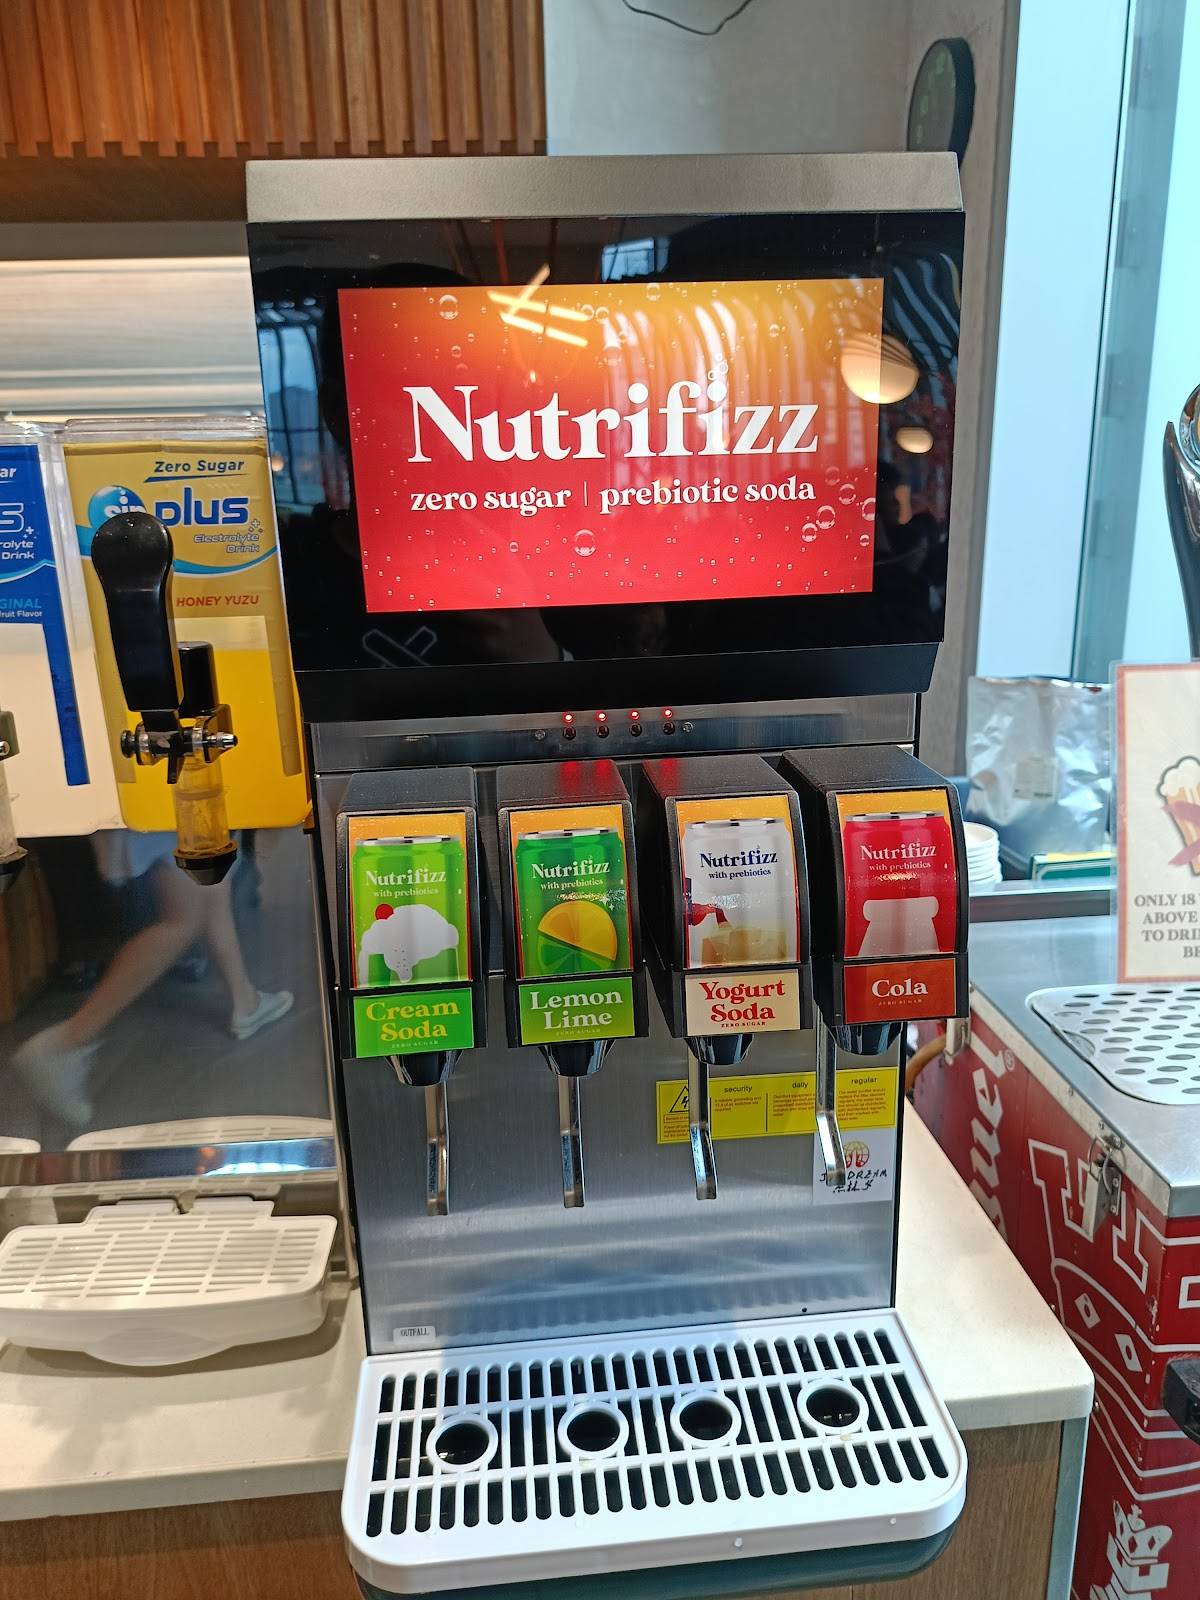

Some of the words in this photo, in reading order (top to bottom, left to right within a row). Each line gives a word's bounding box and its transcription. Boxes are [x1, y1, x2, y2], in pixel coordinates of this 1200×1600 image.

[403, 379, 819, 463] Nutrifizz
[154, 461, 191, 473] Zero
[197, 460, 245, 473] Sugar
[410, 491, 478, 511] zero
[483, 487, 571, 516] sugar
[599, 477, 740, 515] prebiotic
[745, 475, 816, 503] soda
[194, 533, 260, 544] Electrolyte
[1, 551, 35, 560] Drink
[226, 544, 260, 553] Drink
[176, 596, 221, 607] HONEY
[225, 595, 259, 605] YUZU
[16, 610, 43, 618] Flavor
[699, 849, 778, 868] Nutrifizz
[860, 842, 937, 860] Nutrifizz
[531, 859, 610, 879] Nutrifizz
[869, 863, 888, 871] with
[889, 860, 931, 872] prebiotics
[365, 867, 447, 886] Nutrifizz
[708, 871, 727, 879] with
[729, 868, 771, 880] prebiotics
[540, 881, 560, 890] with
[561, 878, 604, 890] prebiotics
[373, 889, 393, 897] with
[394, 887, 439, 899] prebiotics
[1134, 894, 1178, 907] ONLY
[1181, 893, 1196, 905] 18
[1142, 911, 1199, 925] ABOVE
[1141, 929, 1164, 942] TO
[1167, 928, 1200, 941] DRI
[699, 979, 786, 1005] Yogurt
[871, 978, 928, 998] Cola
[529, 991, 624, 1010] Lemon
[366, 1001, 460, 1021] Cream
[710, 1002, 776, 1022] Soda
[543, 1010, 613, 1030] Lime
[381, 1020, 448, 1041] Soda
[724, 1085, 753, 1093] security
[791, 1081, 809, 1089] daily
[851, 1077, 878, 1085] regular
[400, 1327, 430, 1337] OUTFALL
